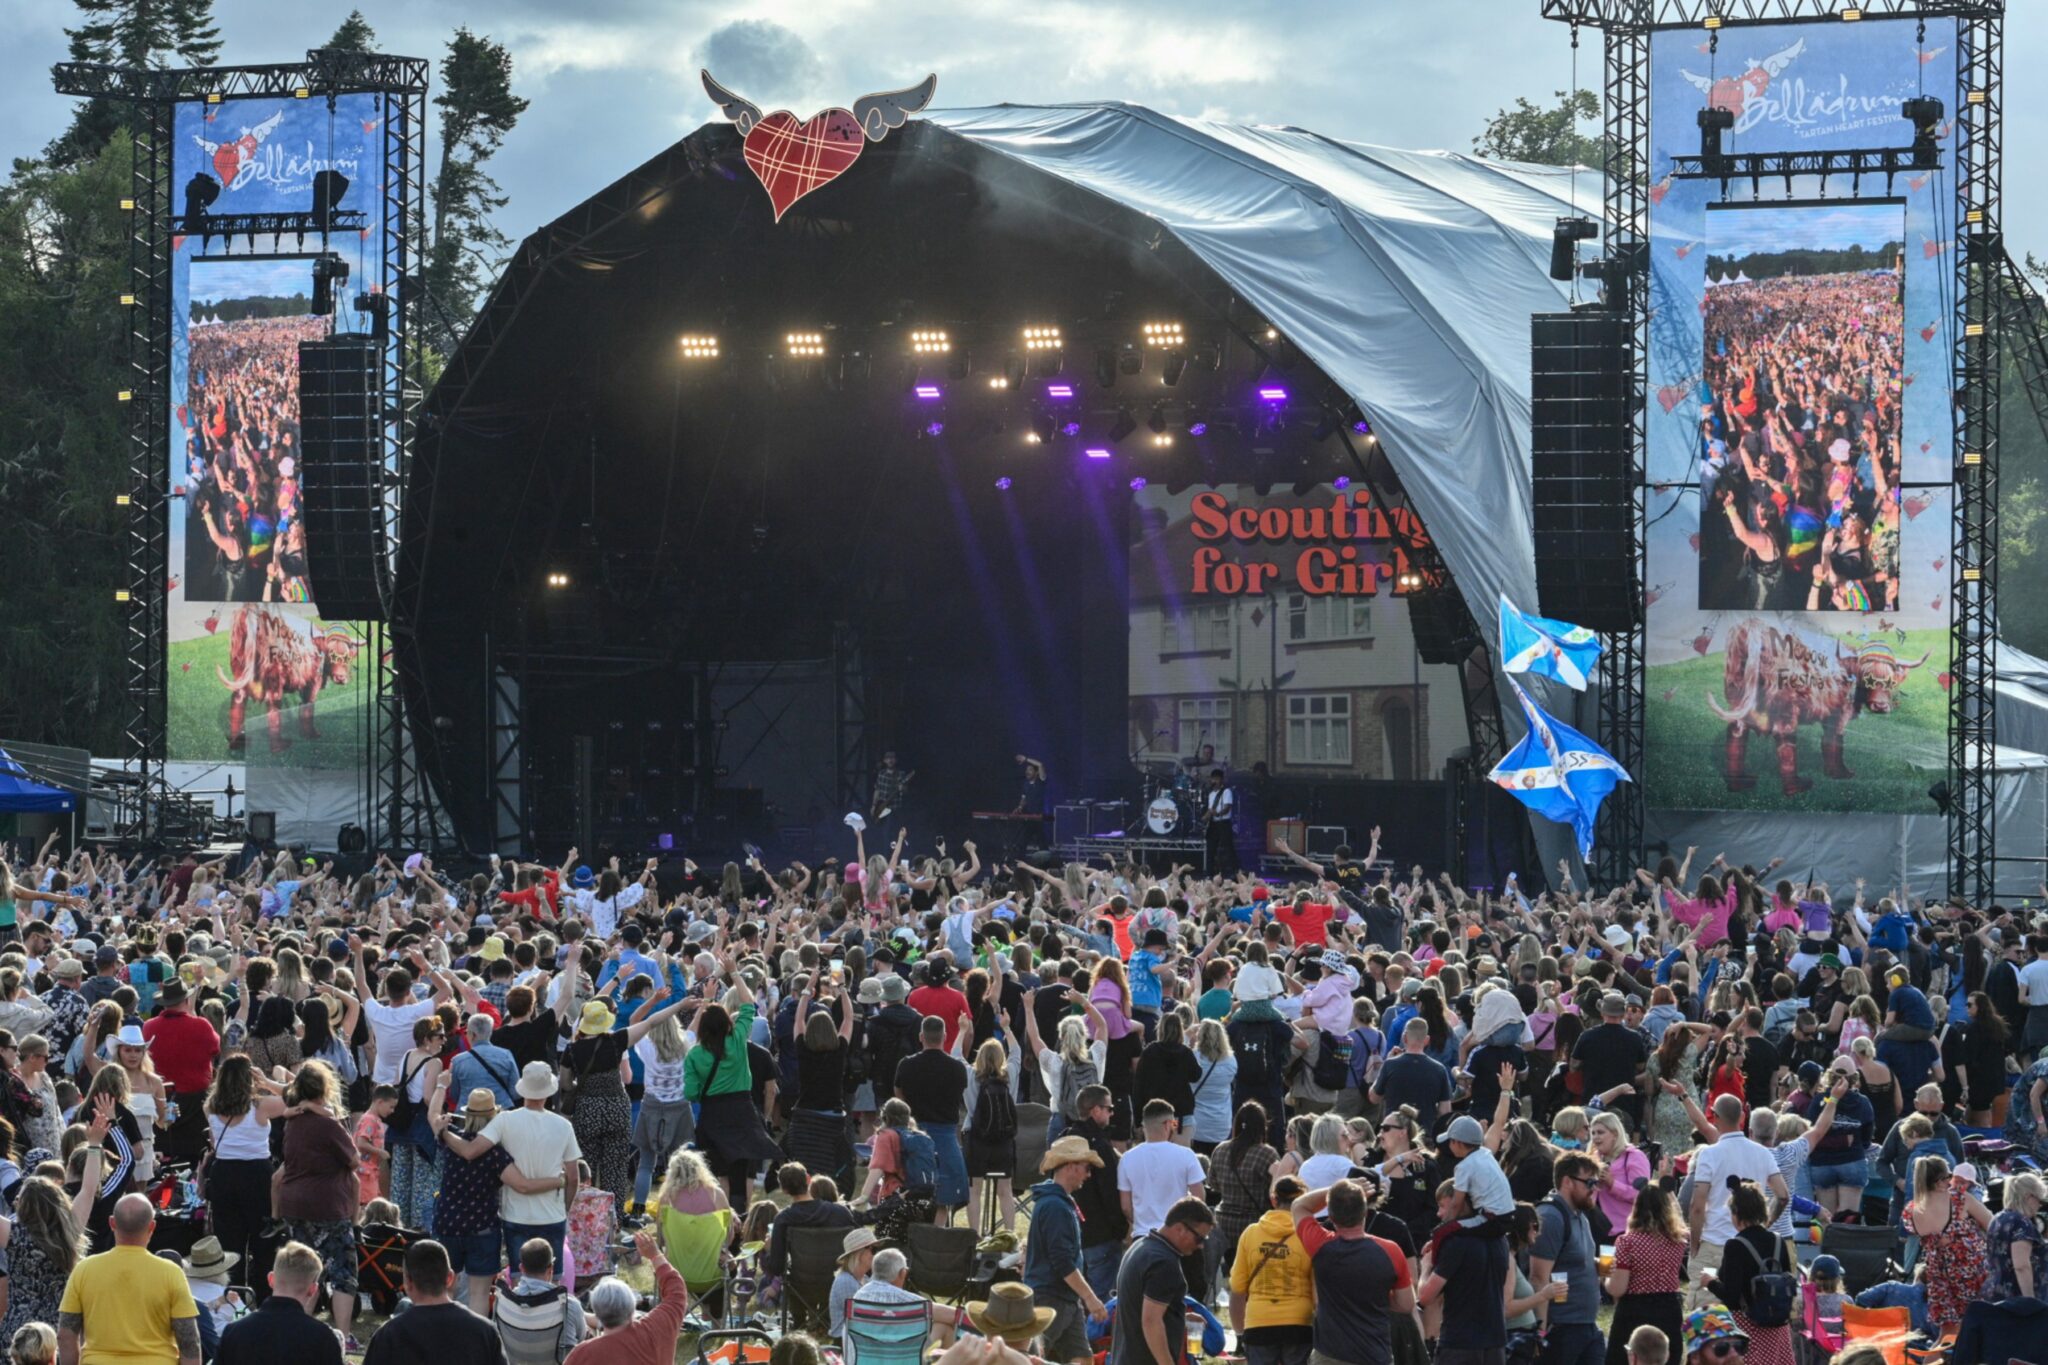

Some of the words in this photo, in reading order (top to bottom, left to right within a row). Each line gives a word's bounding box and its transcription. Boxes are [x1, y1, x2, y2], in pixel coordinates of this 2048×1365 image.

[1800, 126, 1834, 138] TARTAN
[1835, 120, 1865, 132] HEART
[1191, 546, 1279, 593] for
[1296, 546, 1436, 594] Girl
